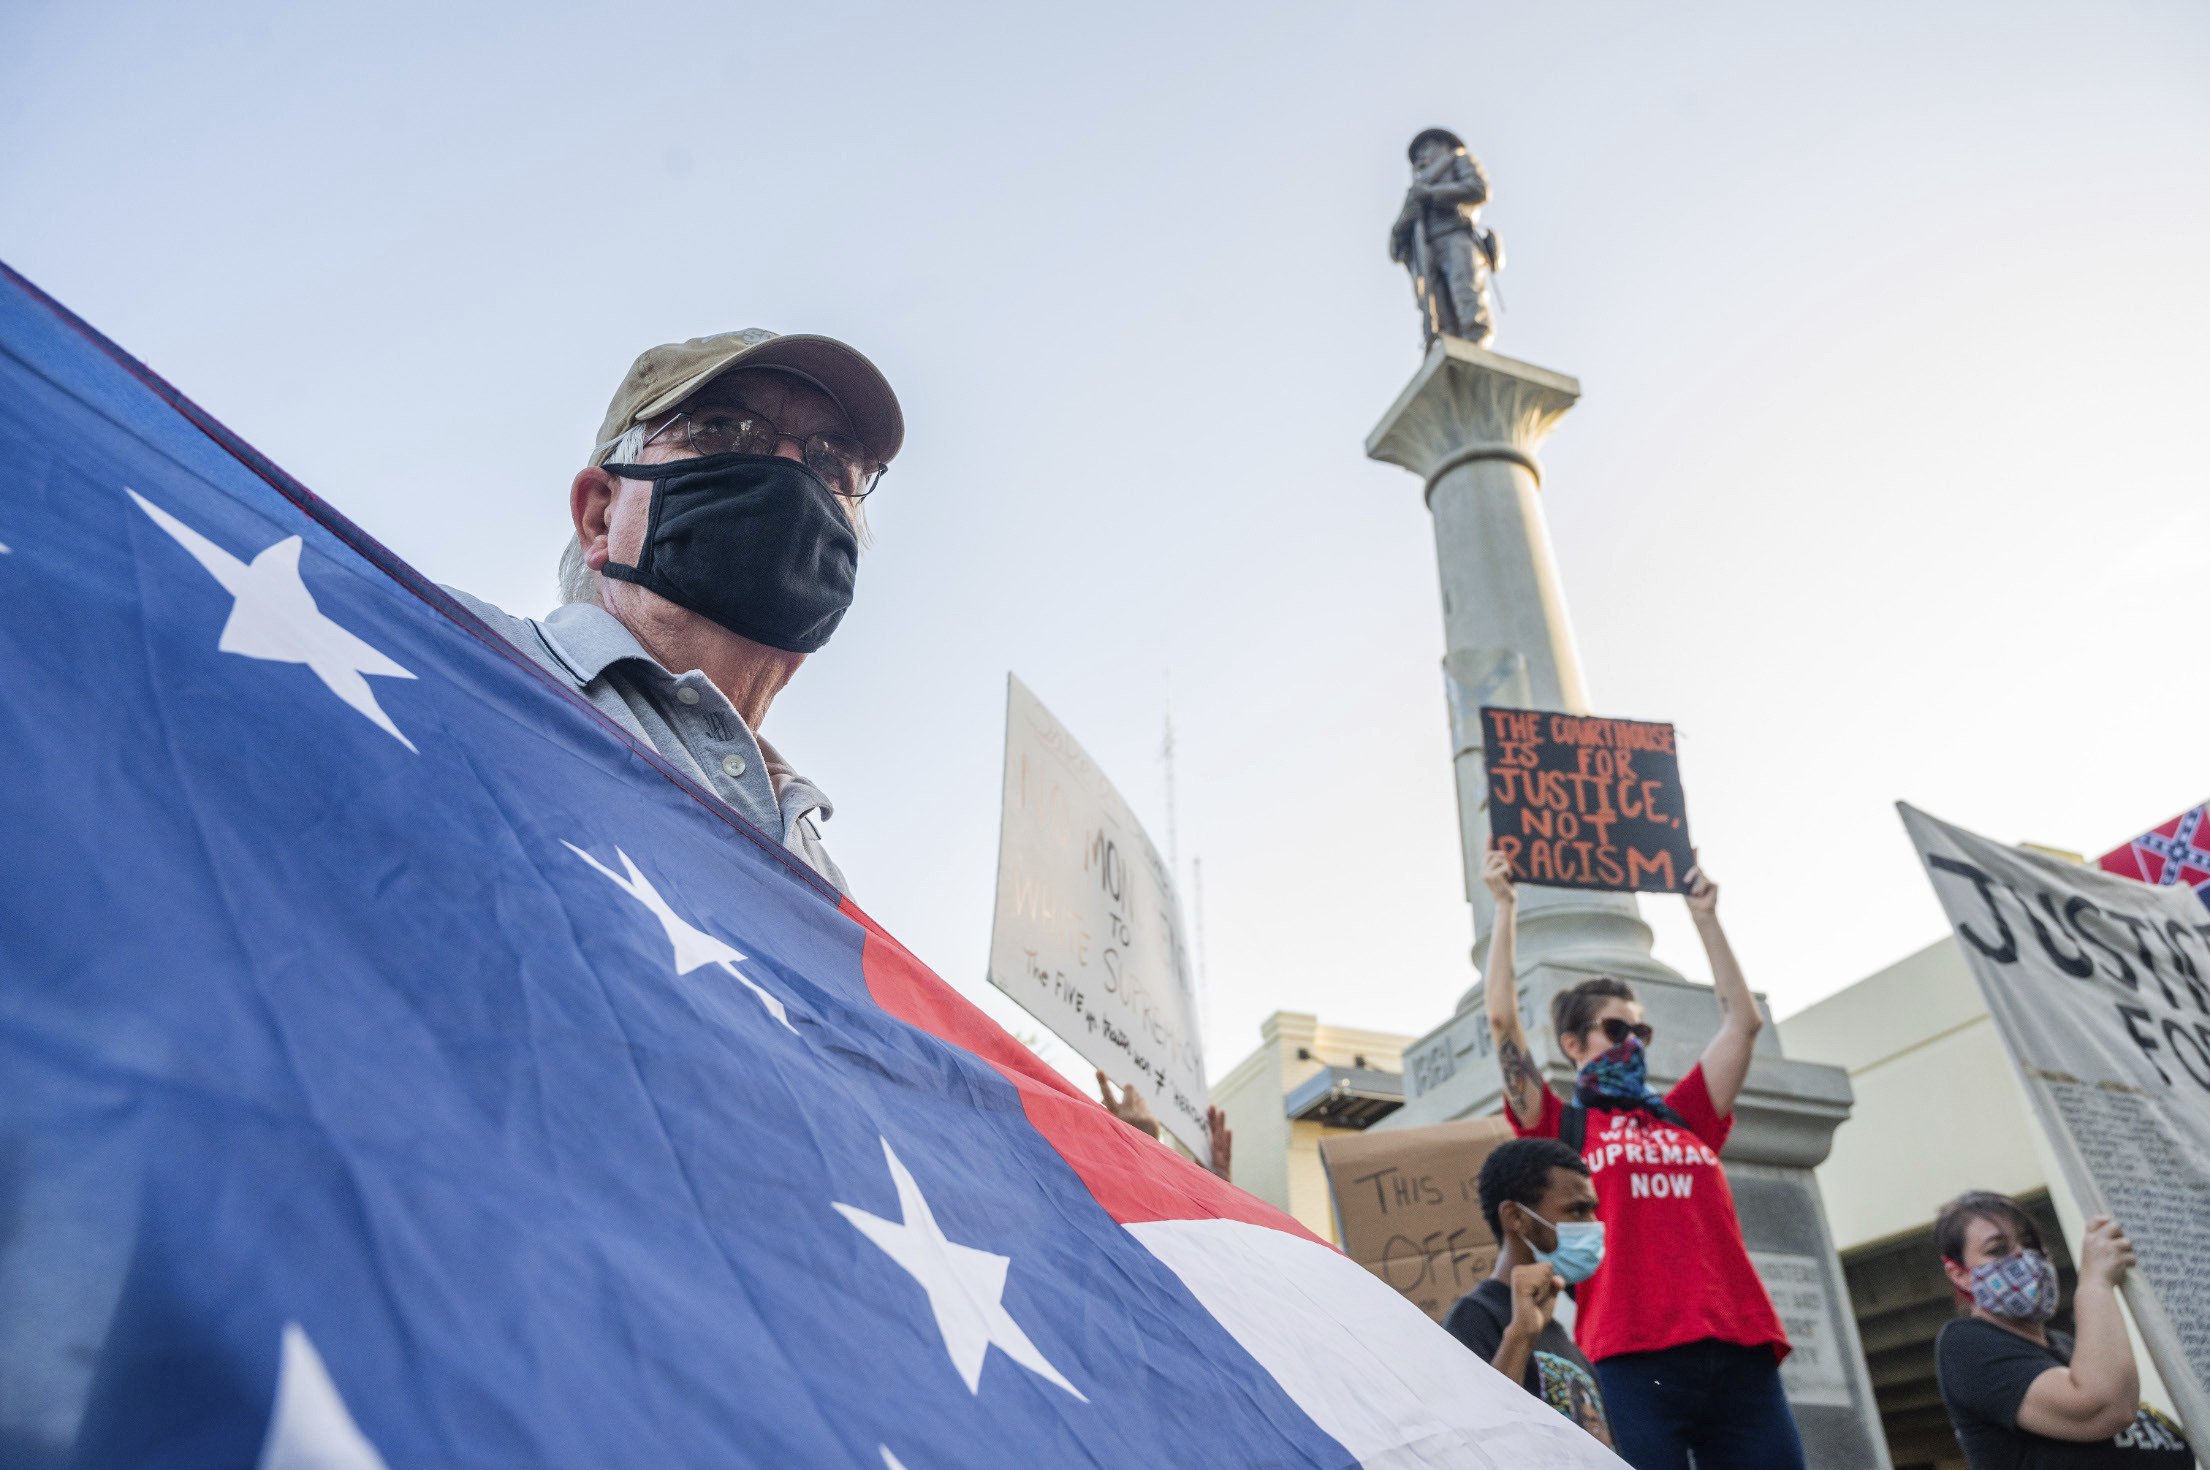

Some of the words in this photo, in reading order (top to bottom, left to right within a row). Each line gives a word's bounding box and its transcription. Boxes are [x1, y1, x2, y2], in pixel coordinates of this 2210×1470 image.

[1489, 711, 1544, 743] THE
[1499, 742, 1540, 769] IS
[1577, 748, 1638, 781] FOR
[1520, 807, 1617, 849] NOT
[1497, 834, 1675, 890] RACISM
[1927, 853, 2210, 1016] JUSTIC
[2115, 1003, 2210, 1093] FO
[1581, 1143, 1718, 1173] UPREMAC
[1353, 1166, 1445, 1215] THIS
[1629, 1172, 1694, 1199] NOW
